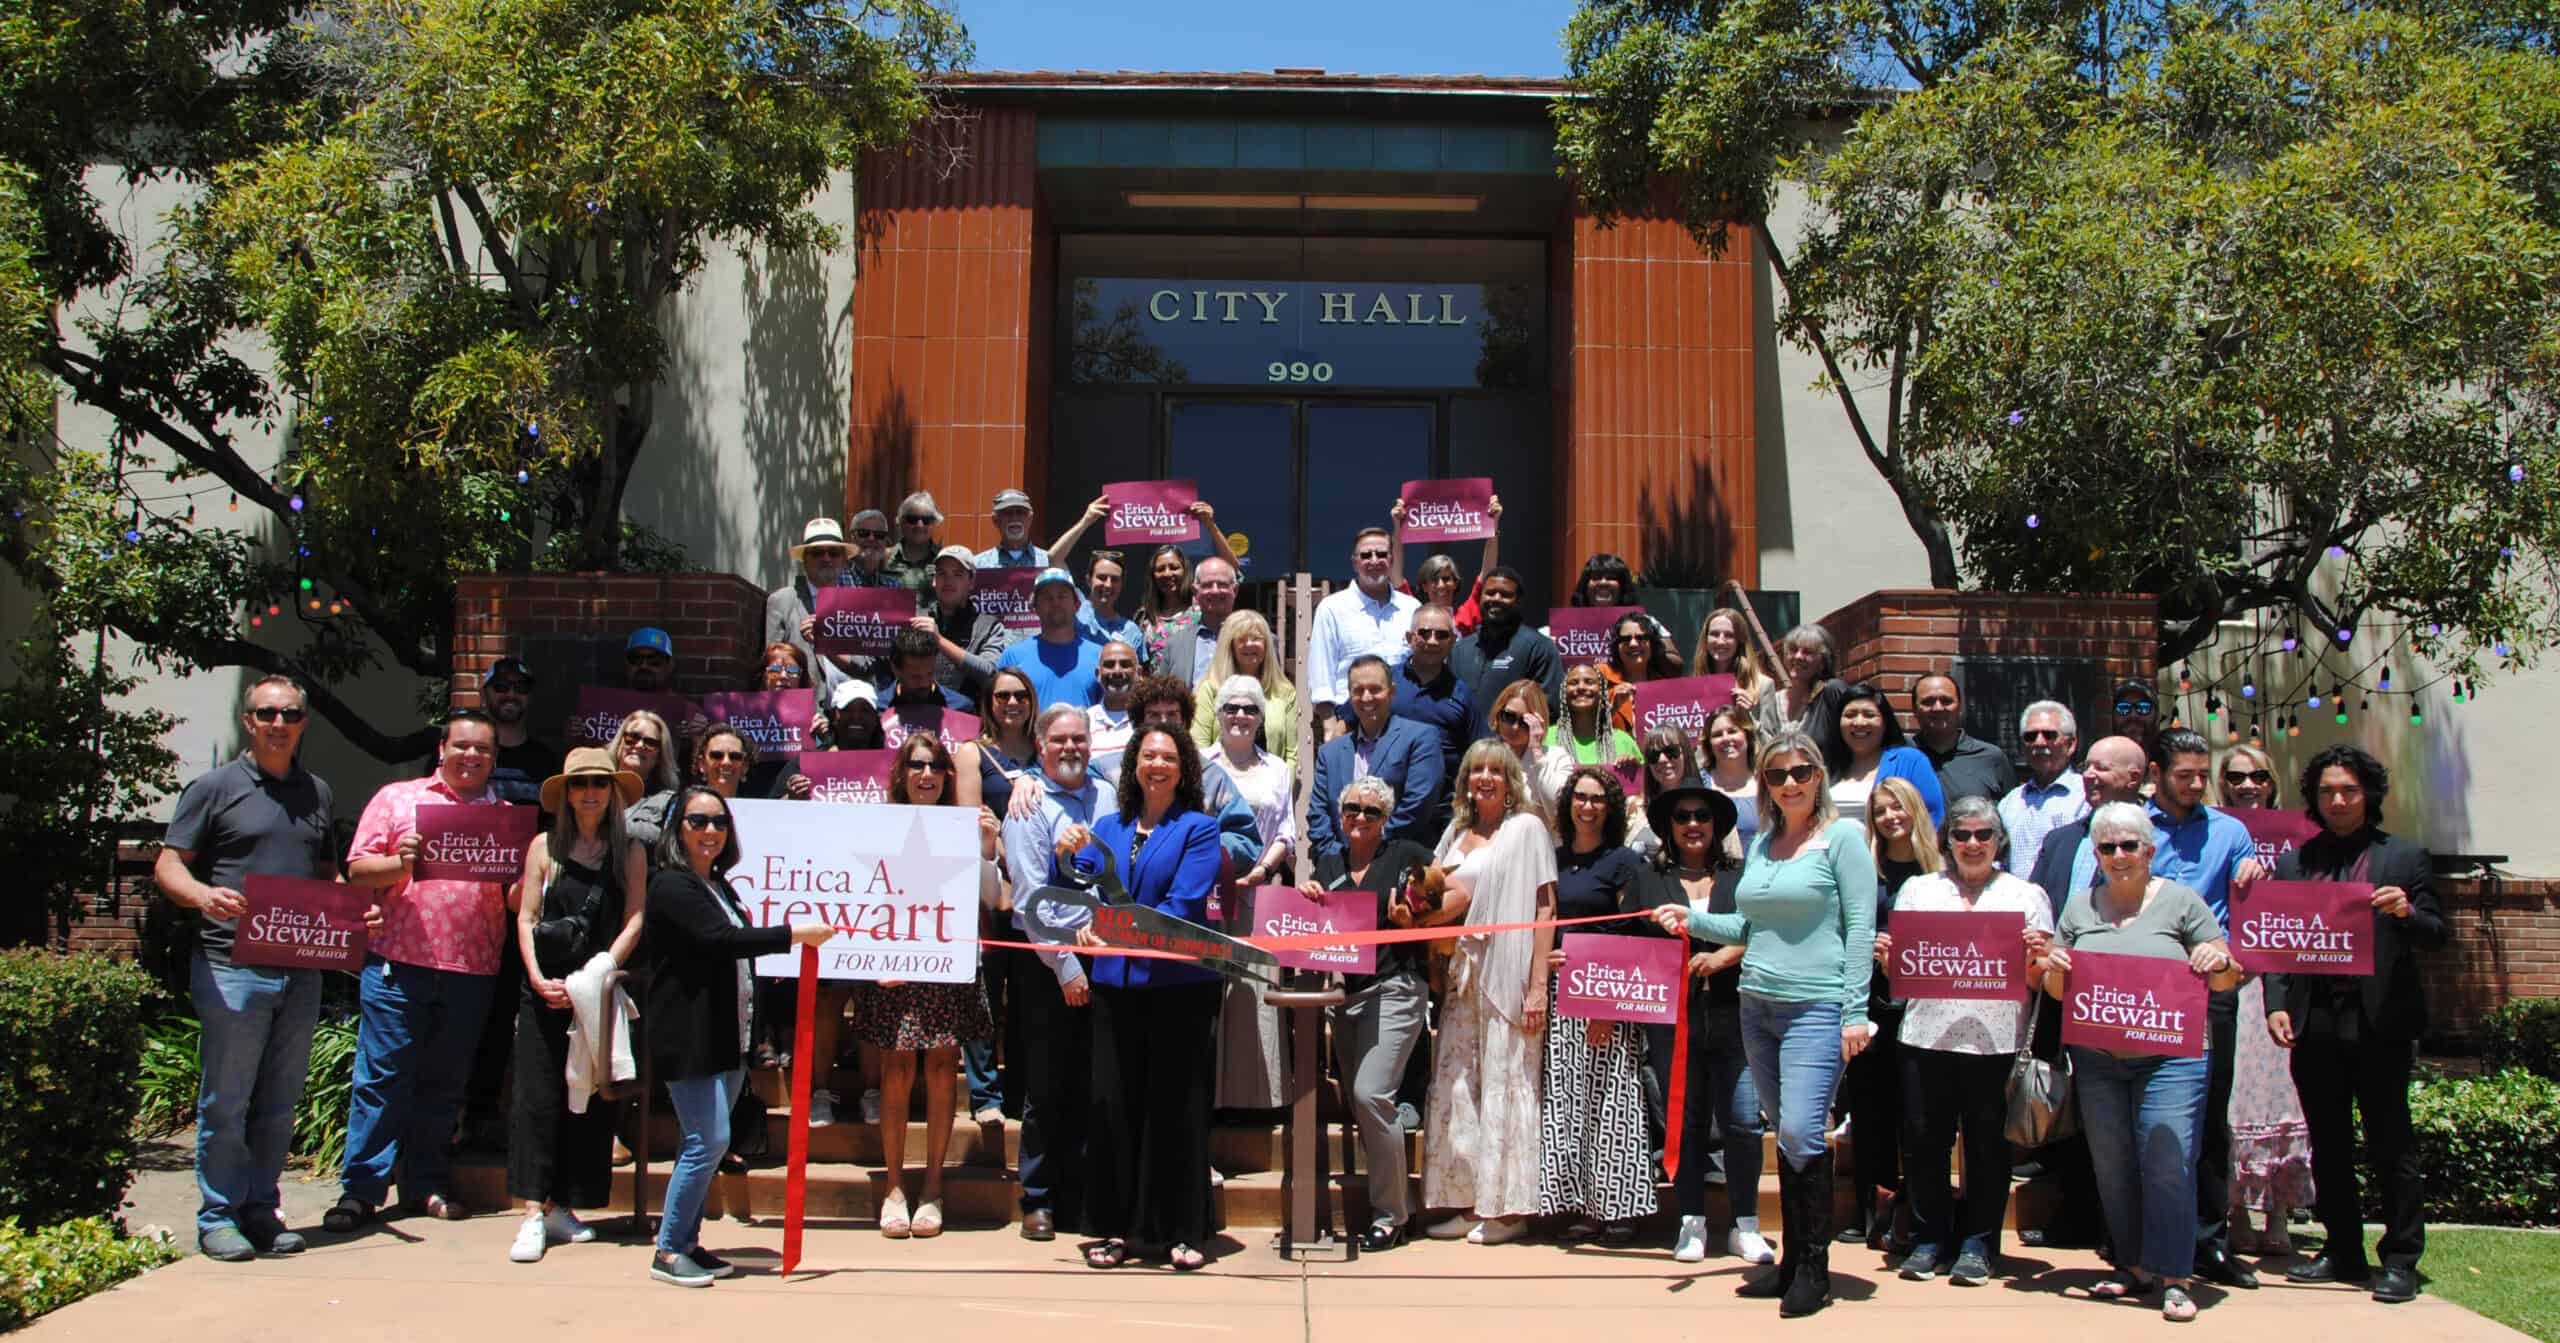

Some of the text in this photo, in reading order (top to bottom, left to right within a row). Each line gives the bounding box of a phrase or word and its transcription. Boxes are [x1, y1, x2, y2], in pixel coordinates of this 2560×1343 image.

[1150, 290, 1467, 324] CITY HALL
[1268, 362, 1333, 382] 990
[1124, 502, 1170, 514] Erica A.
[1420, 501, 1465, 514] Erica A.
[1113, 510, 1187, 528] Stewart
[1408, 508, 1481, 528] Stewart
[980, 588, 1024, 600] Erica A.
[969, 595, 1032, 613] Stewar
[836, 610, 885, 624] Erica A.
[1569, 628, 1612, 641] Erica A
[1558, 636, 1611, 656] Stew
[1656, 700, 1705, 716] Erica A.
[729, 714, 782, 729] Erica A.
[1644, 711, 1710, 732] Stwa
[743, 726, 802, 743] wart
[827, 776, 882, 791] Erica A.
[811, 785, 889, 803] Stewa
[443, 832, 500, 847] Erica A.
[2253, 838, 2293, 854] ica A
[424, 840, 520, 863] Stewart
[760, 855, 904, 896] Erica A.
[269, 907, 332, 928] Erica A.
[1281, 913, 1339, 935] Erica A.
[2260, 912, 2329, 930] Erica A.
[248, 914, 352, 948] Stewart
[2241, 920, 2353, 950] Stewart
[296, 948, 348, 960] FOR MAYOR
[1310, 952, 1327, 961] FOR
[1918, 941, 1983, 957] Erica A.
[2296, 953, 2353, 962] FOR MAYOR
[833, 953, 953, 974] FOR MAYOR
[1586, 962, 1647, 982] Erica A.
[1900, 949, 2007, 977] Stewart
[1567, 969, 1669, 1002] Stewart
[1952, 980, 2007, 989] FOR MAYOR
[2093, 985, 2160, 1008] Erica A.
[1616, 1002, 1667, 1013] FOR MAYOR
[2073, 992, 2185, 1031] Stewart
[2125, 1030, 2184, 1044] FOR MAYOR
